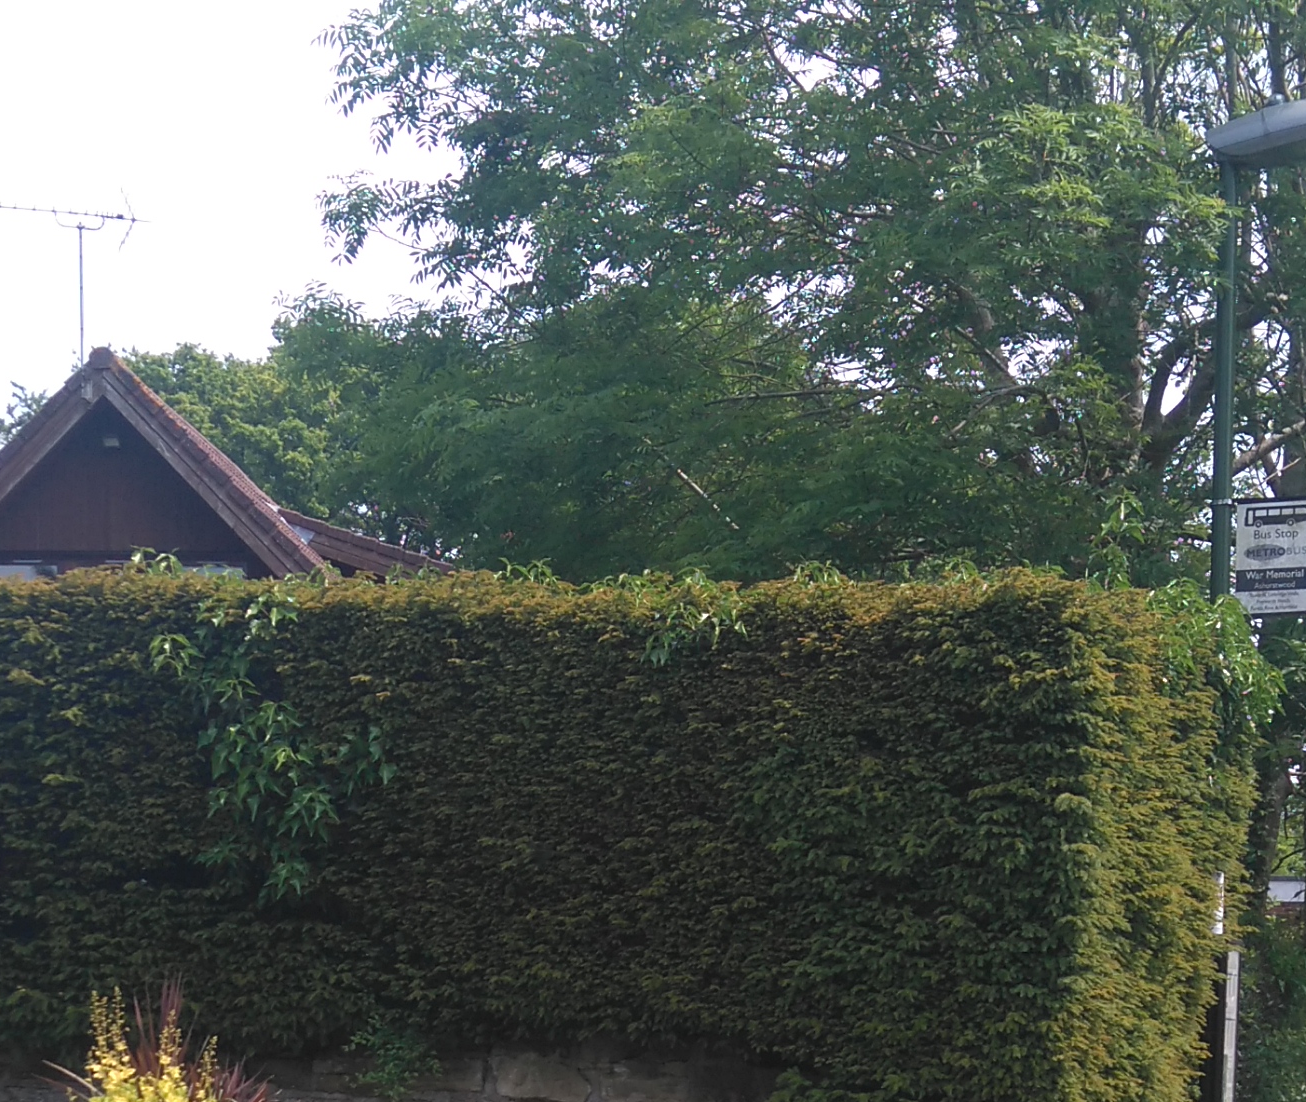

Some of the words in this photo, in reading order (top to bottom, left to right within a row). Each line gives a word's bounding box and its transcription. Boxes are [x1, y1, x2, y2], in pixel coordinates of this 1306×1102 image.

[1253, 530, 1272, 540] Bus
[1275, 529, 1299, 541] Stop
[1245, 571, 1263, 579] War
[1266, 569, 1305, 579] Memorial
